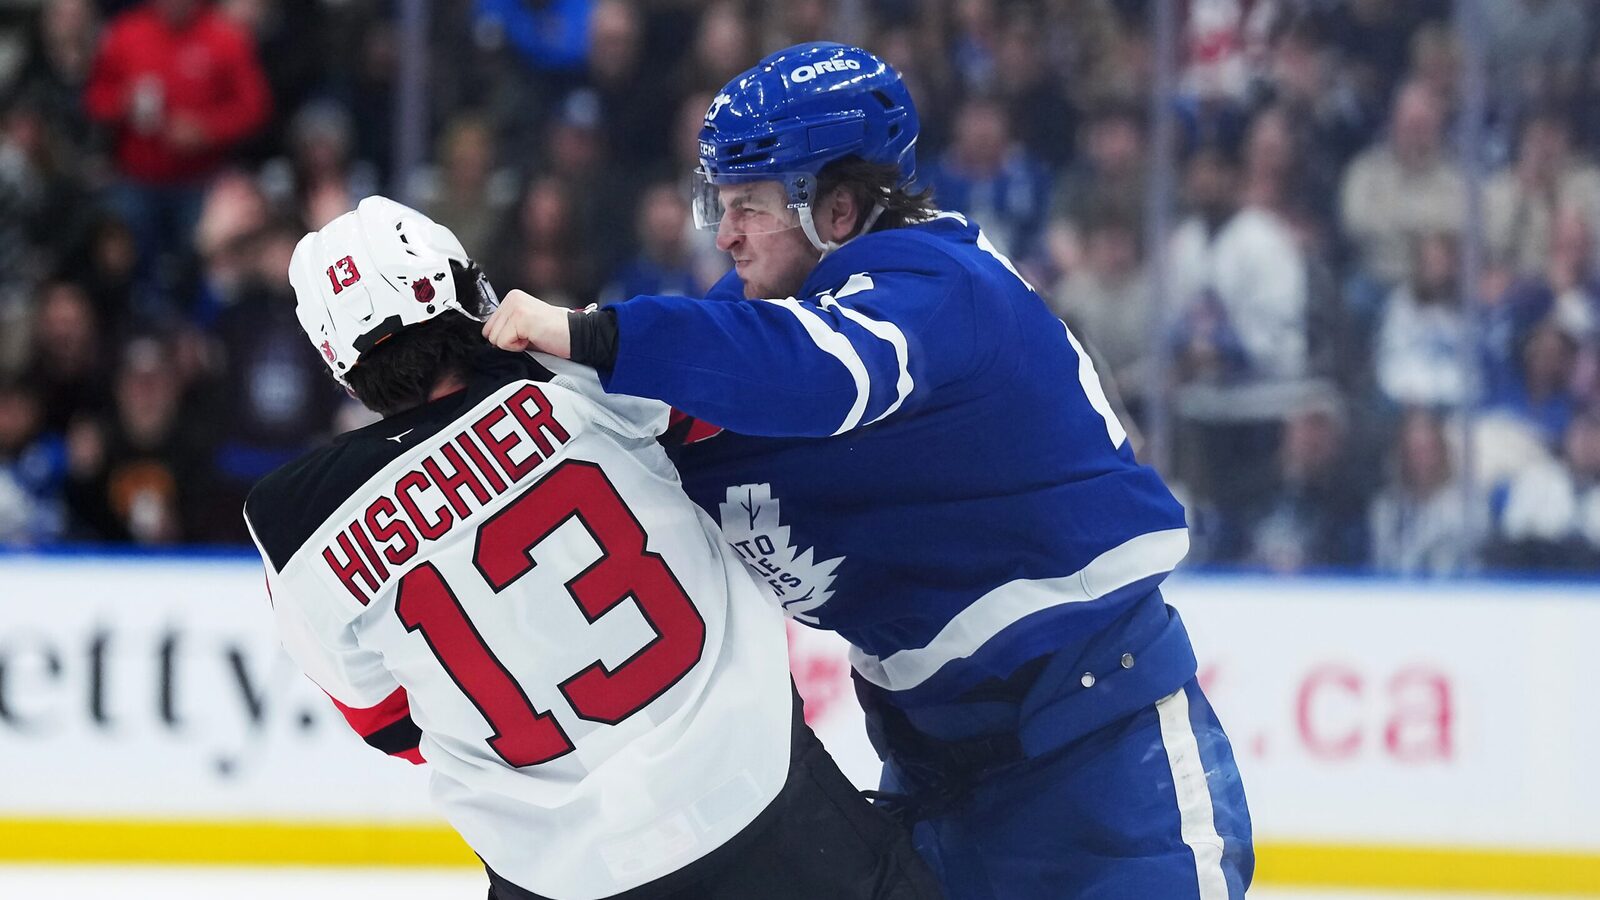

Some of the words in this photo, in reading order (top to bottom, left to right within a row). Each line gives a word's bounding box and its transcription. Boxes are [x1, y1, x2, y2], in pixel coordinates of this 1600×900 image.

[790, 58, 861, 83] OREO
[326, 255, 361, 295] 13
[322, 384, 571, 607] HISCHIER
[395, 458, 706, 769] 13
